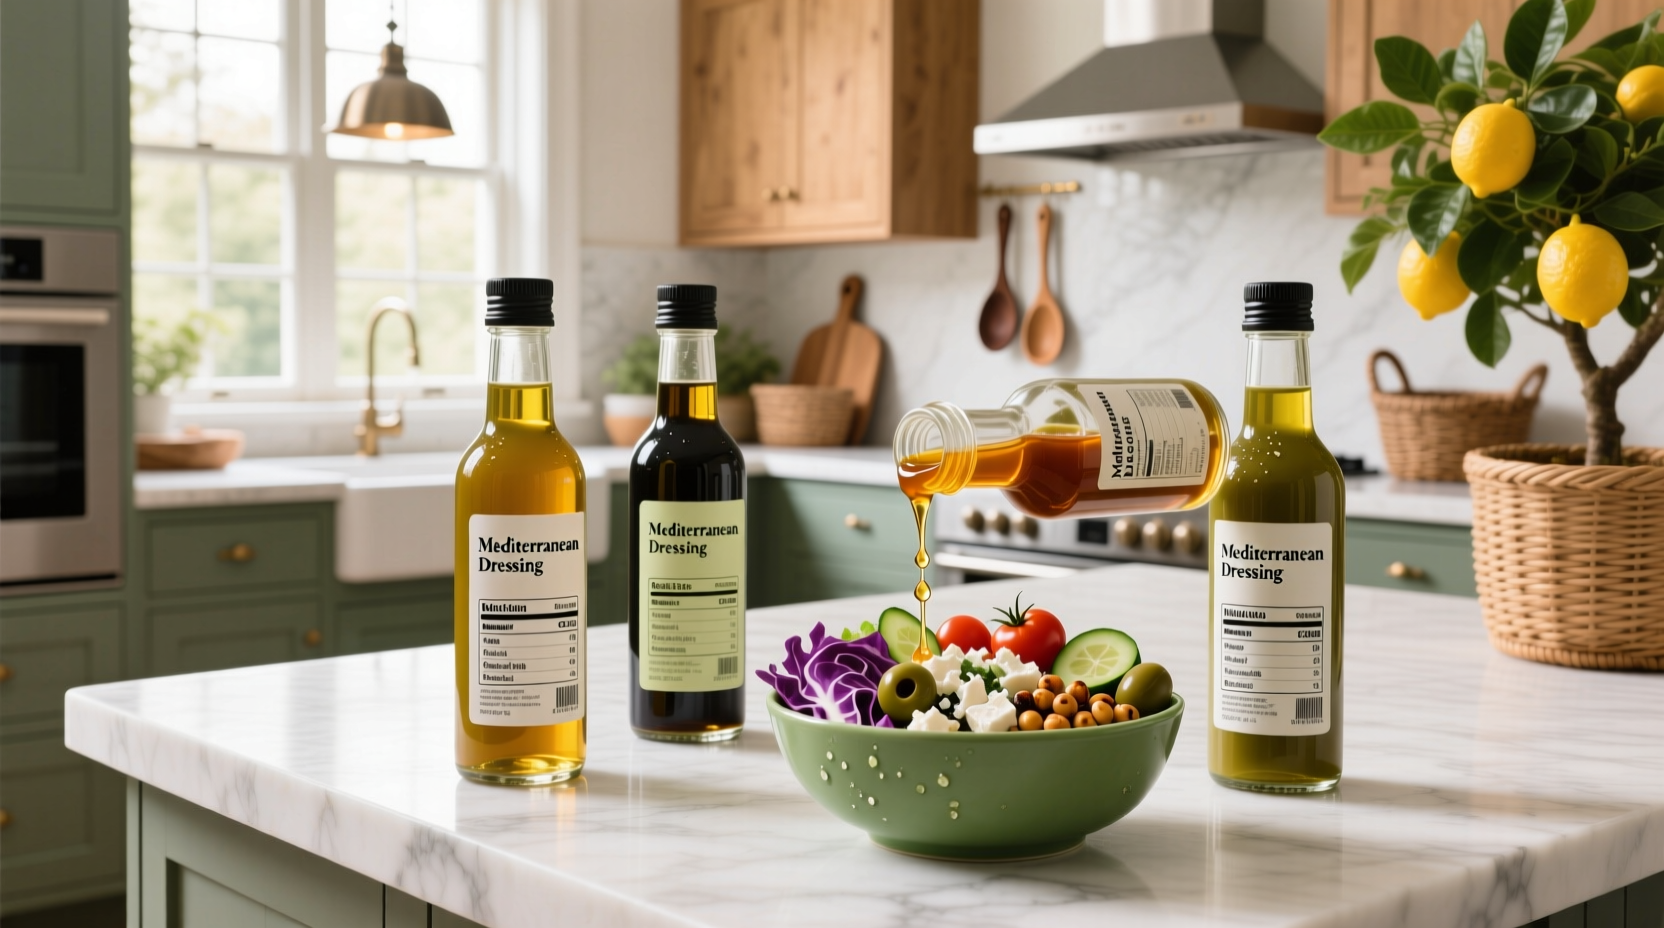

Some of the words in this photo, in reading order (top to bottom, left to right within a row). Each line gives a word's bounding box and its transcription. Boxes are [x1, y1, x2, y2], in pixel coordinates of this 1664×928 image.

[478, 536, 580, 553] Mediterranean
[649, 539, 708, 558] Dressing
[1221, 543, 1324, 561] Mediterranean
[478, 556, 544, 577] Dressing
[1221, 562, 1285, 584] Dressing
